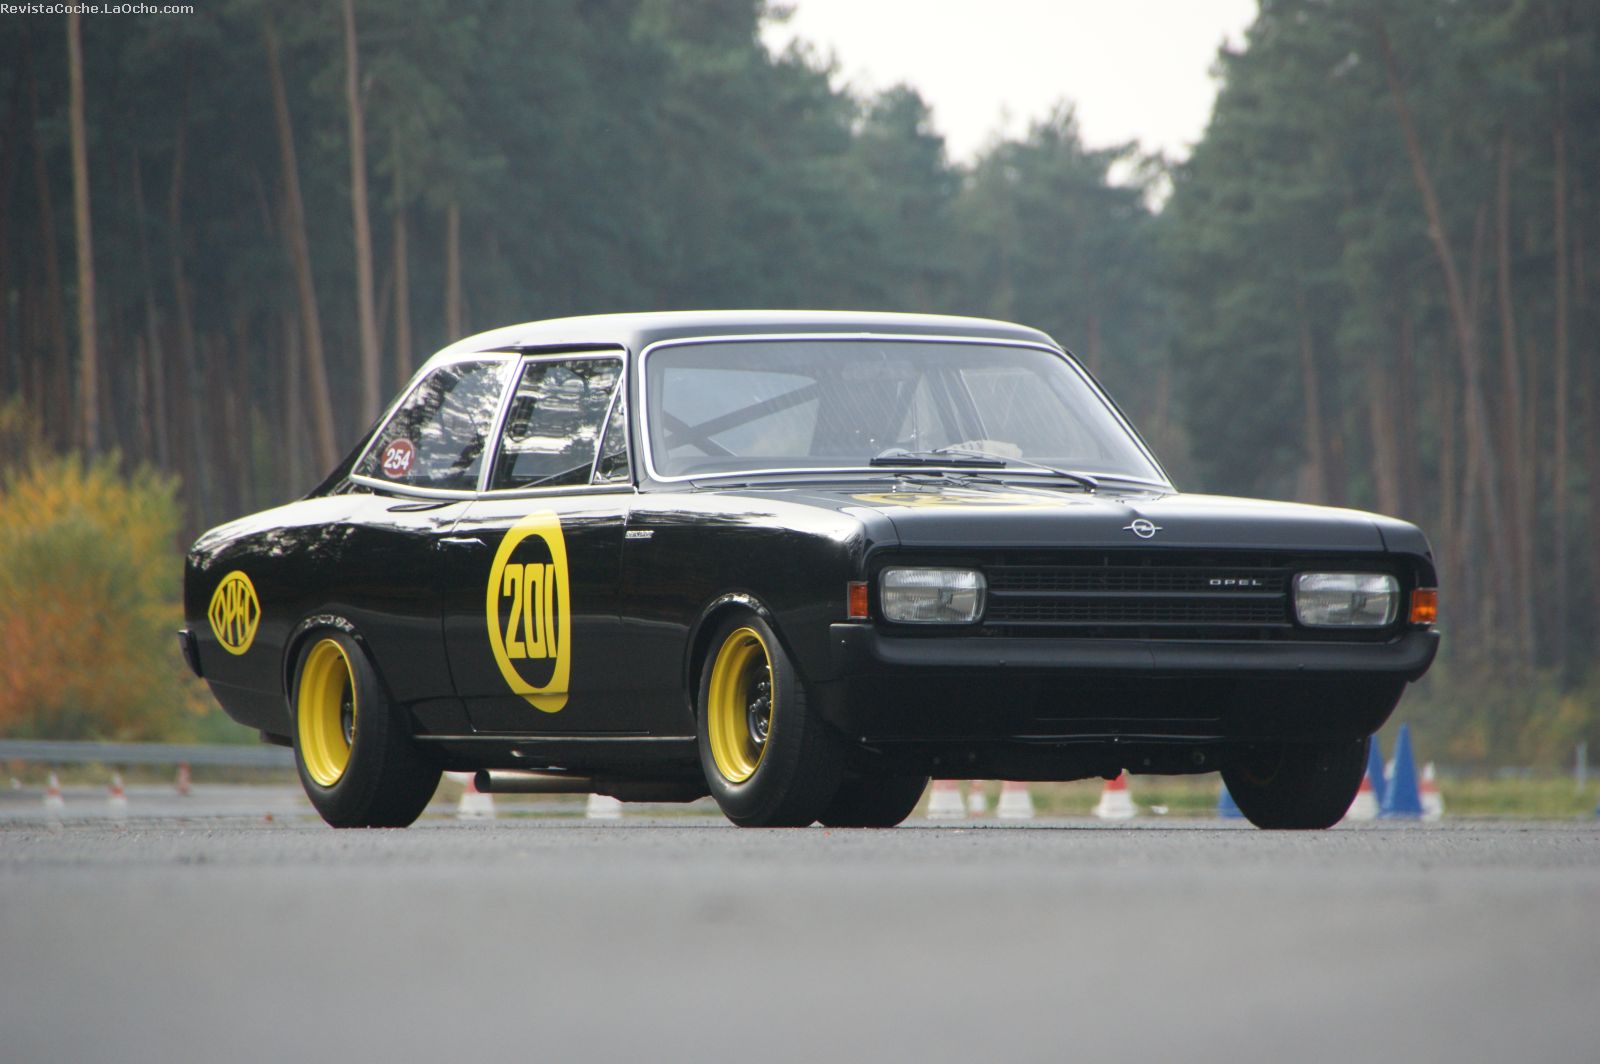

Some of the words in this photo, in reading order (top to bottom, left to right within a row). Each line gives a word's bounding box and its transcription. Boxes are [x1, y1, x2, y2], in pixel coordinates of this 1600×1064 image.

[384, 447, 411, 470] 254
[214, 579, 254, 646] OPEL
[503, 563, 557, 659] 201
